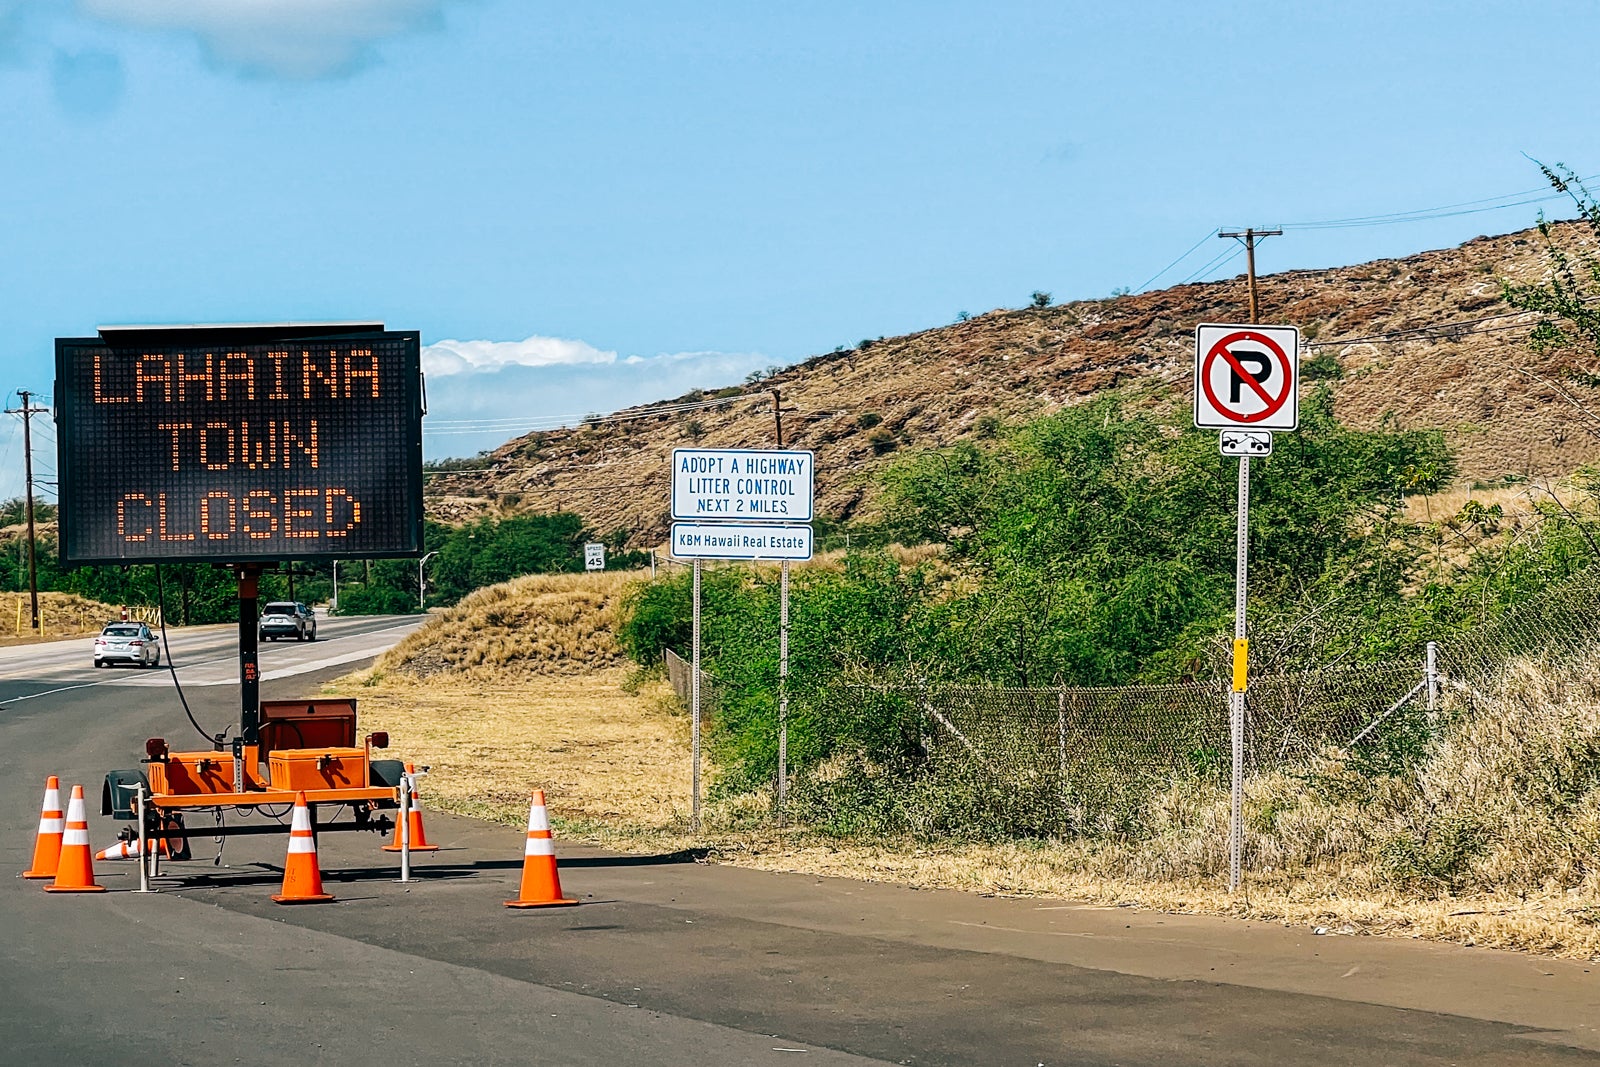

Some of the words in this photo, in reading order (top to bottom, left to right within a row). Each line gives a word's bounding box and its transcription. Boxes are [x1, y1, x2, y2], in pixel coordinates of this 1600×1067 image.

[94, 349, 379, 403] LAHAINA
[1230, 350, 1272, 403] P
[158, 420, 318, 471] TOWN
[681, 456, 723, 473] ADOPT
[731, 458, 739, 474] A
[746, 458, 804, 475] HIGHWAY
[689, 478, 730, 494] LITTER
[737, 479, 795, 496] CONTROL
[117, 488, 361, 542] CLOSED
[698, 499, 730, 512] NEXT
[736, 500, 744, 512] 2
[750, 500, 787, 513] MILES
[680, 534, 701, 546] KBM
[704, 535, 740, 547] Hawaii
[743, 536, 767, 548] Real
[770, 537, 804, 549] Estate
[588, 558, 602, 566] 45
